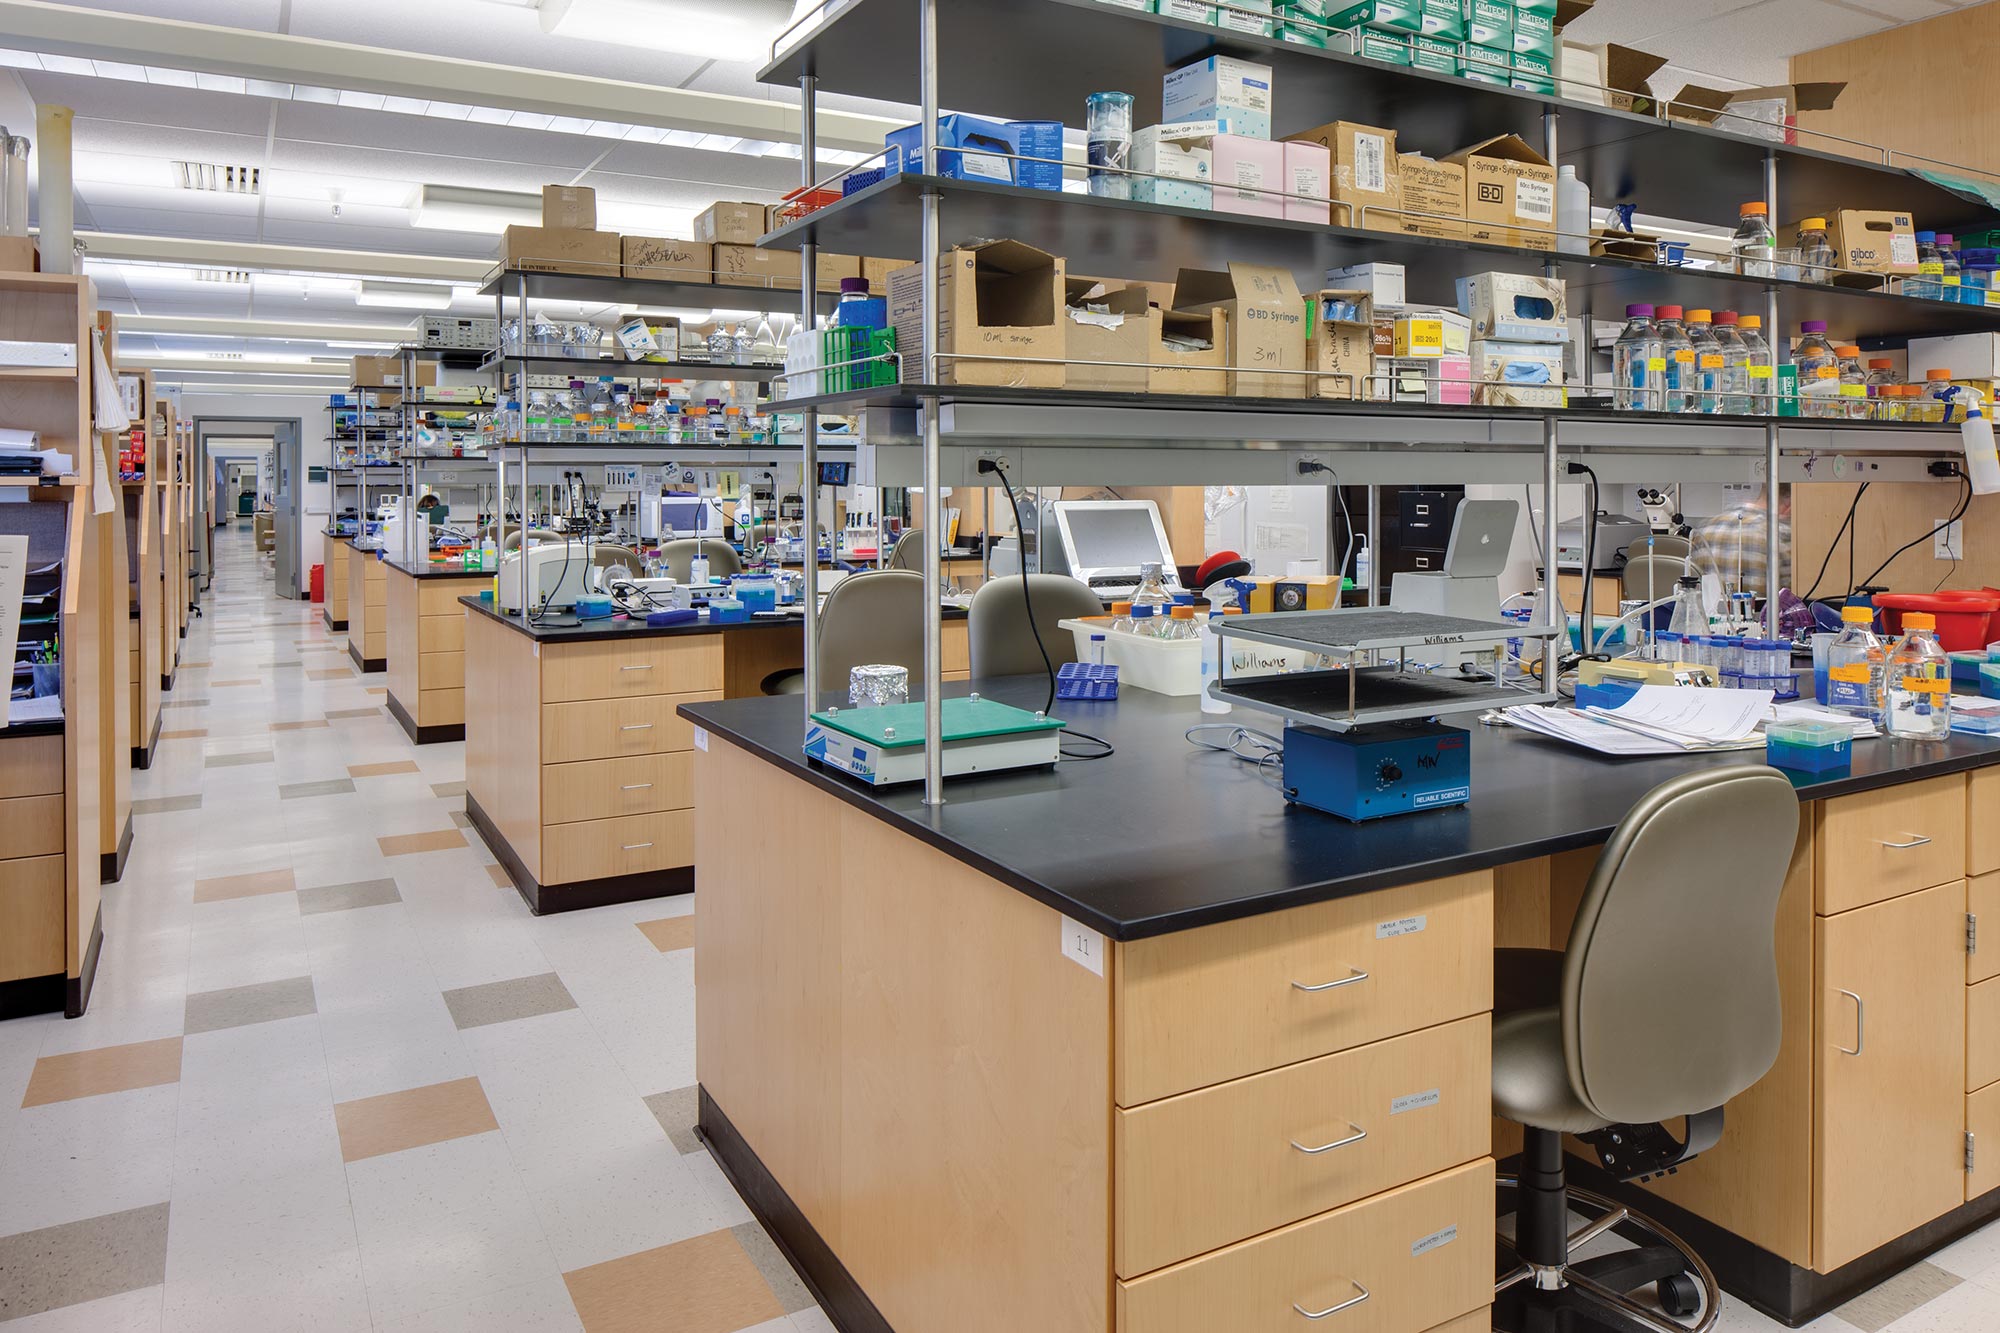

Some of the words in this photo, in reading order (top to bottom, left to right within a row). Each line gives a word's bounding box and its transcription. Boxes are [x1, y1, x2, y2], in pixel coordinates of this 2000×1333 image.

[1476, 1, 1507, 17] KIMTECH
[1519, 11, 1549, 27] KIMTECH
[1419, 41, 1453, 54] KIMTECH
[1470, 46, 1503, 63] KIMTECH
[1515, 57, 1547, 72] KIMTECH
[1476, 161, 1498, 173] Syringe
[1502, 165, 1524, 177] Syringe
[1528, 168, 1550, 181] Syringe
[1530, 184, 1548, 193] Syringe
[1850, 248, 1875, 262] gibco
[1256, 310, 1268, 320] BD
[1270, 311, 1300, 324] Syringe
[1424, 634, 1464, 645] Williams
[1232, 652, 1286, 673] Williams
[1416, 794, 1440, 804] RELIABLE
[1440, 790, 1466, 800] SCIENTIFIC
[1076, 934, 1089, 956] 11
